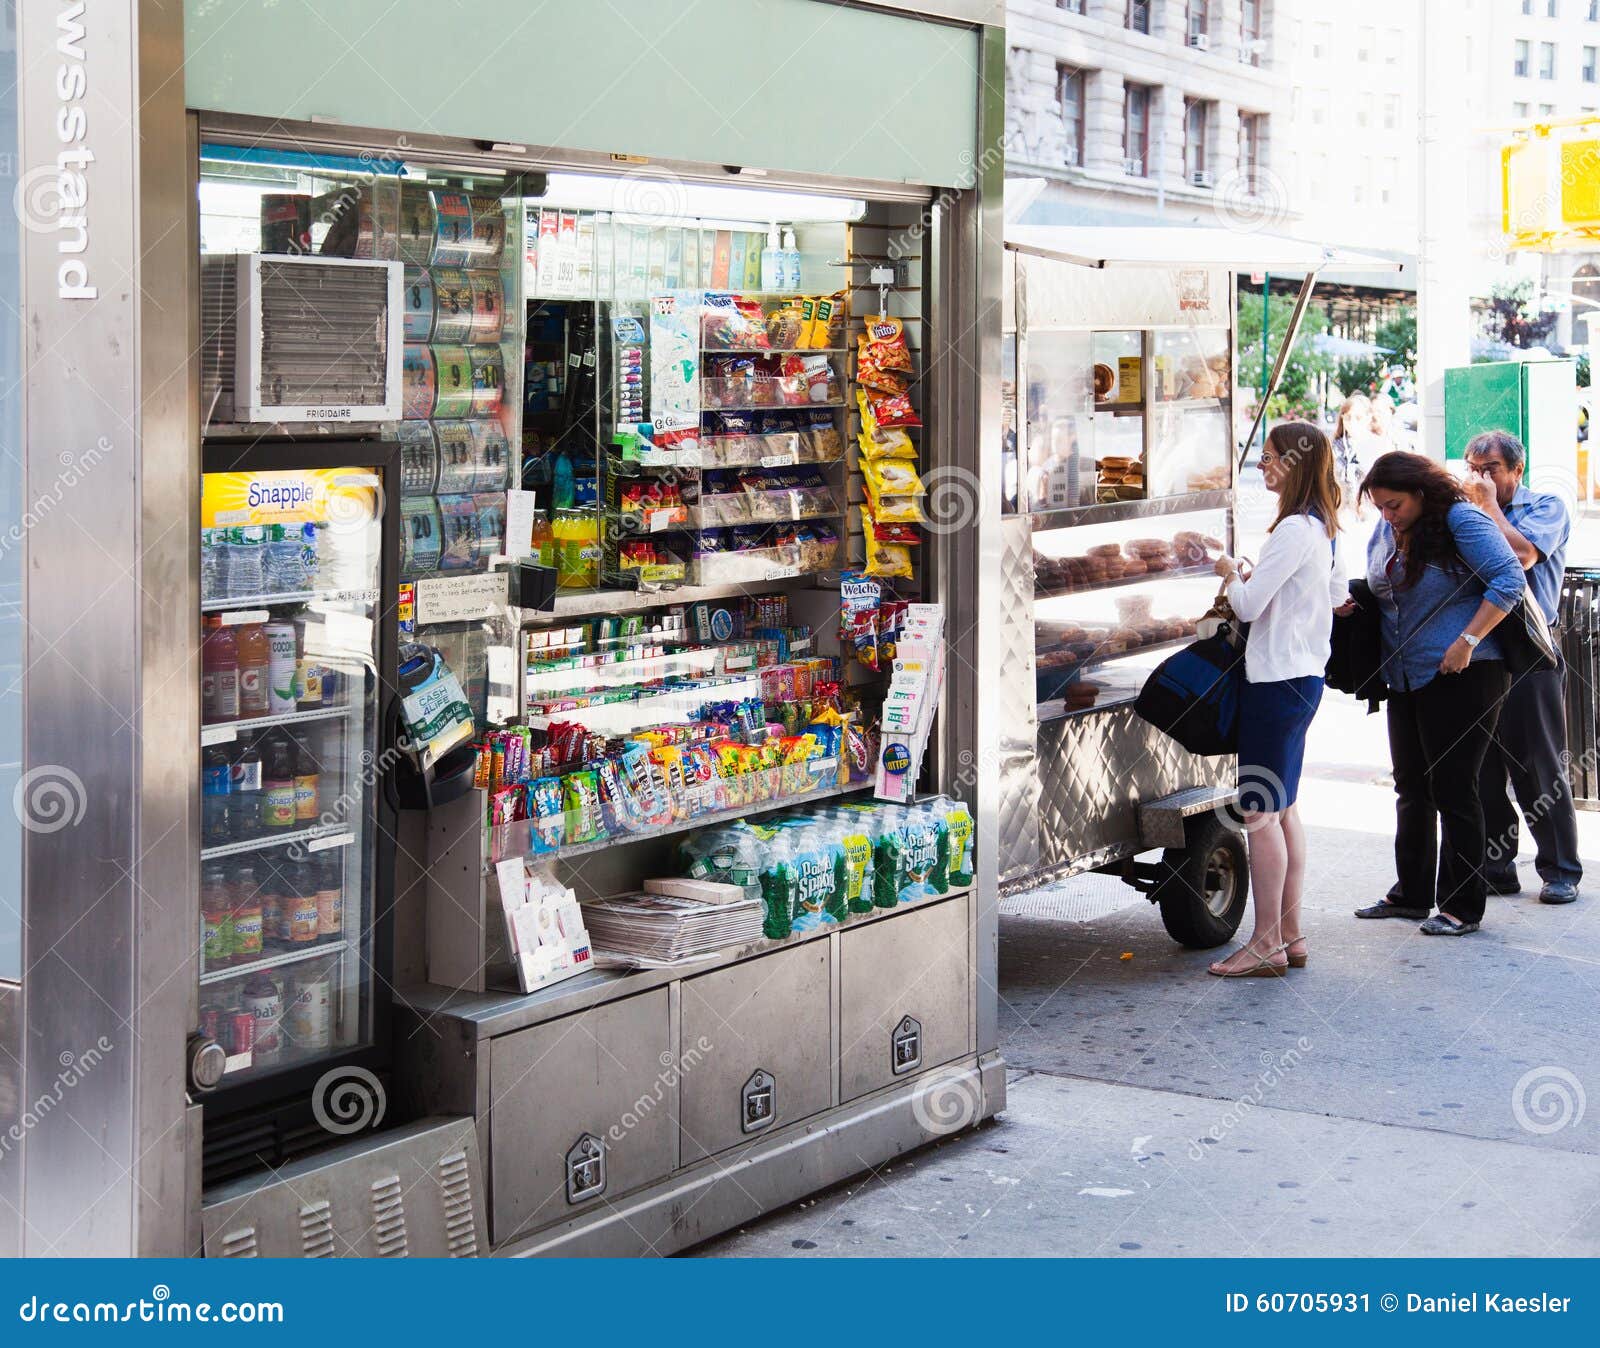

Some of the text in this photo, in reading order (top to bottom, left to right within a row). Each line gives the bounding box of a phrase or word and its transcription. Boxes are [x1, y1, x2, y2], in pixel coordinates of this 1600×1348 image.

[412, 285, 421, 309] 8
[452, 364, 460, 387] 9
[306, 409, 351, 418] FRIGIDAIRE
[248, 481, 314, 509] Snapple
[412, 514, 431, 540] 20
[843, 583, 880, 596] Welch's
[240, 670, 260, 691] G
[419, 686, 448, 707] CASH
[423, 696, 450, 716] 4LIFE
[887, 759, 909, 771] LOTTERY
